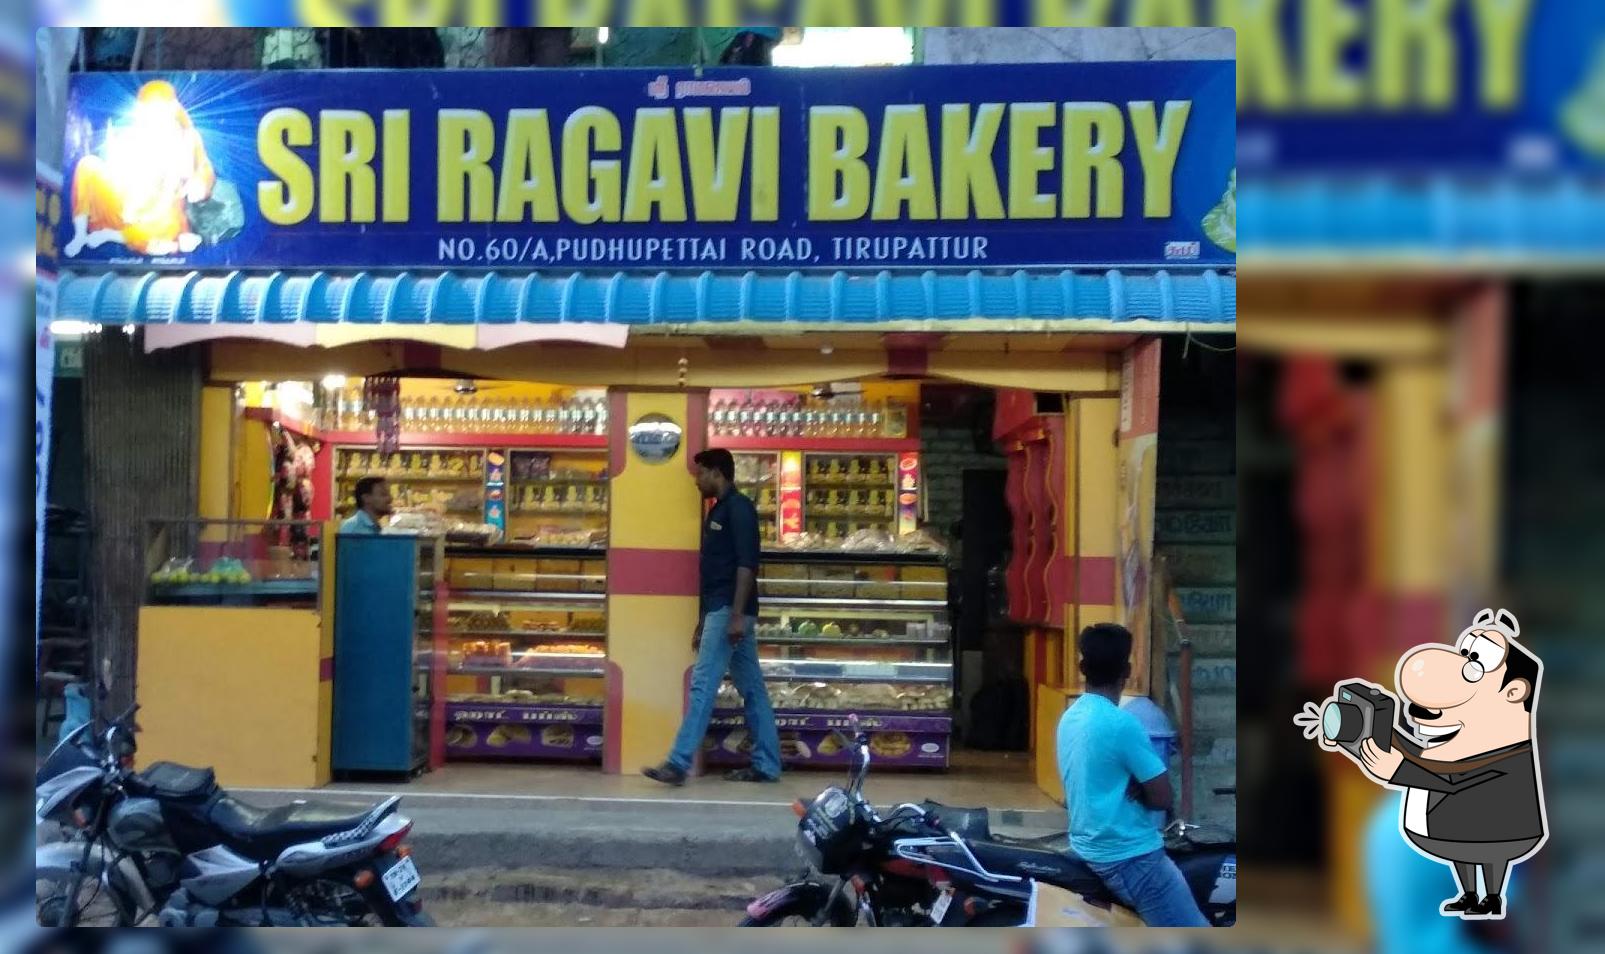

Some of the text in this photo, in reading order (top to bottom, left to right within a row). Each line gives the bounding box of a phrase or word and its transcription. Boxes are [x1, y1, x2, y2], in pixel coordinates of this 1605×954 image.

[256, 100, 1192, 225] SRI RAGAVI BAKERY
[740, 237, 820, 262] ROAD,
[833, 236, 989, 260] TIRUPATTUR
